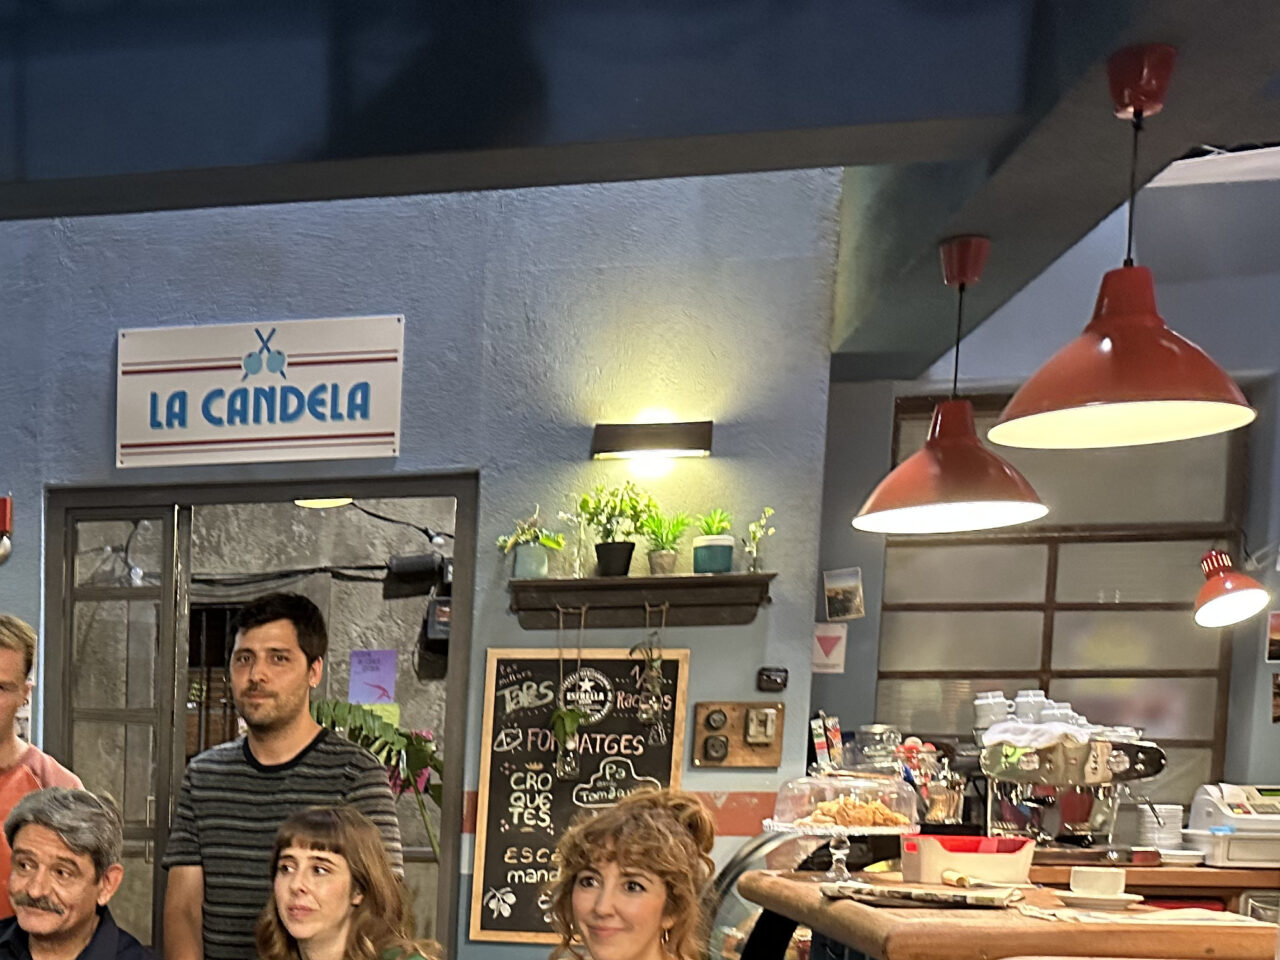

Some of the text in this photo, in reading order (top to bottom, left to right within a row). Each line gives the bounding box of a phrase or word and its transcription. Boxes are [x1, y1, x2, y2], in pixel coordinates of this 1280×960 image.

[150, 381, 370, 430] LA CANDELA
[510, 771, 552, 791] CRO
[508, 807, 551, 828] TES
[507, 866, 562, 884] mand
